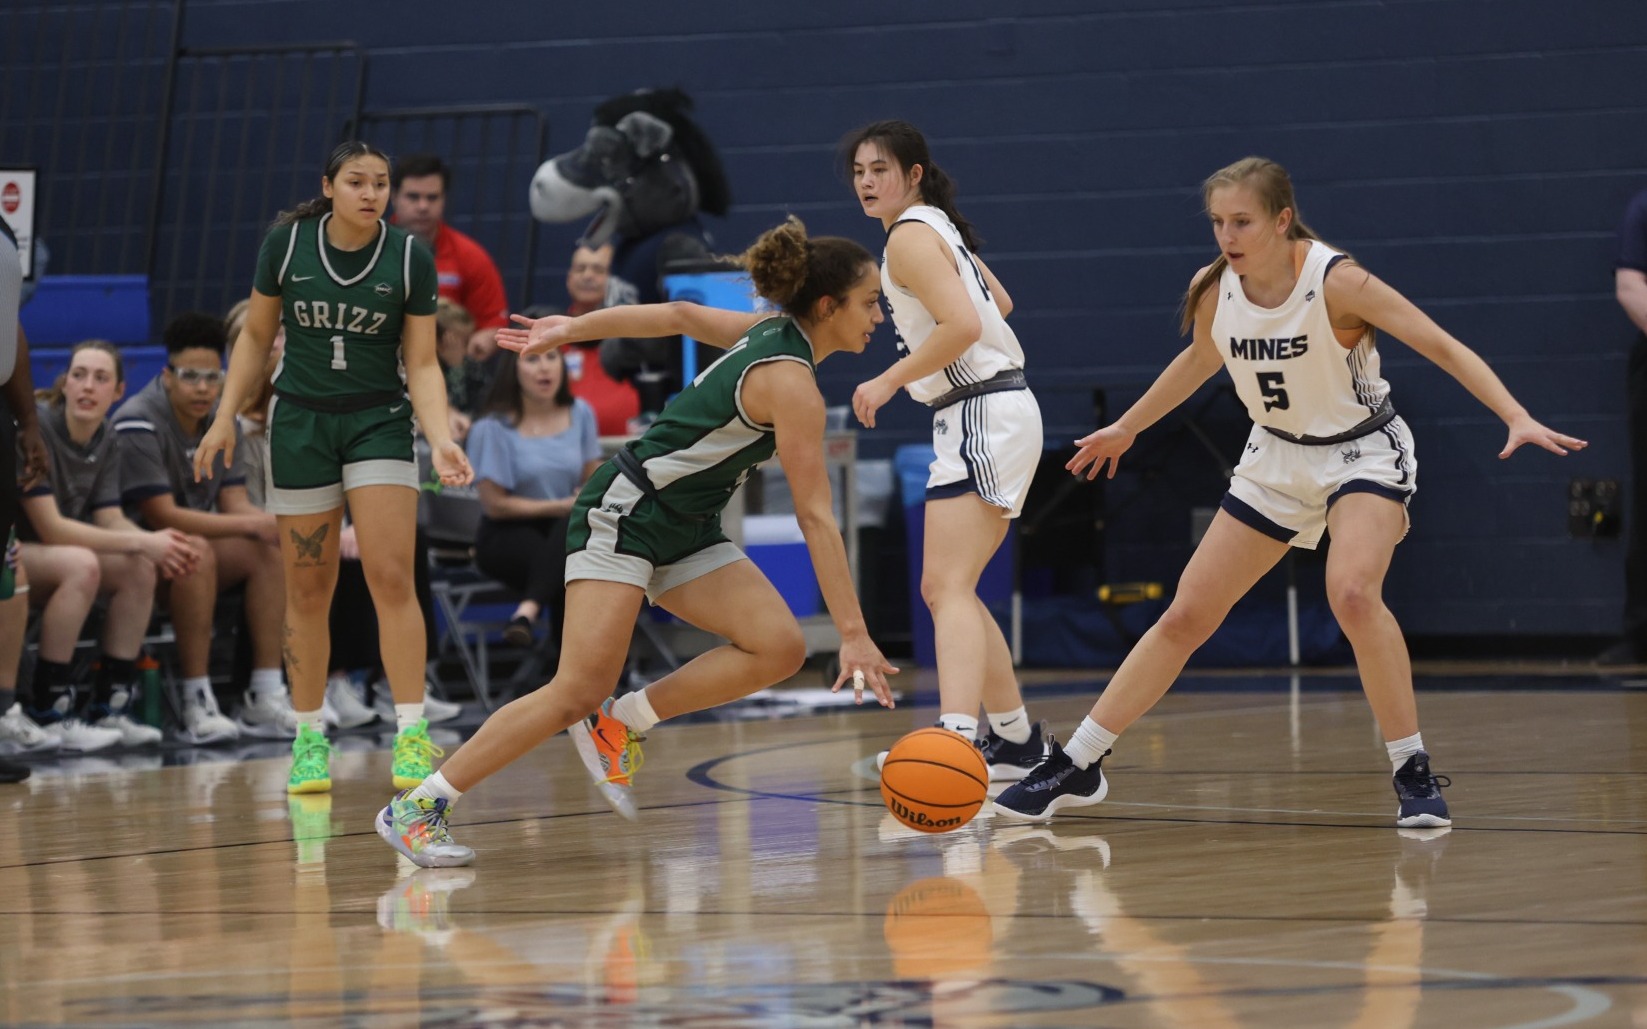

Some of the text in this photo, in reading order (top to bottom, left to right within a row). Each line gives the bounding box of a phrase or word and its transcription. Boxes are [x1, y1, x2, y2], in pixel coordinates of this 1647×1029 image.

[293, 300, 387, 334] GRIZZ
[329, 335, 347, 370] 1
[1230, 334, 1308, 360] MINES
[1256, 372, 1290, 413] 5
[891, 797, 961, 827] Wilson
